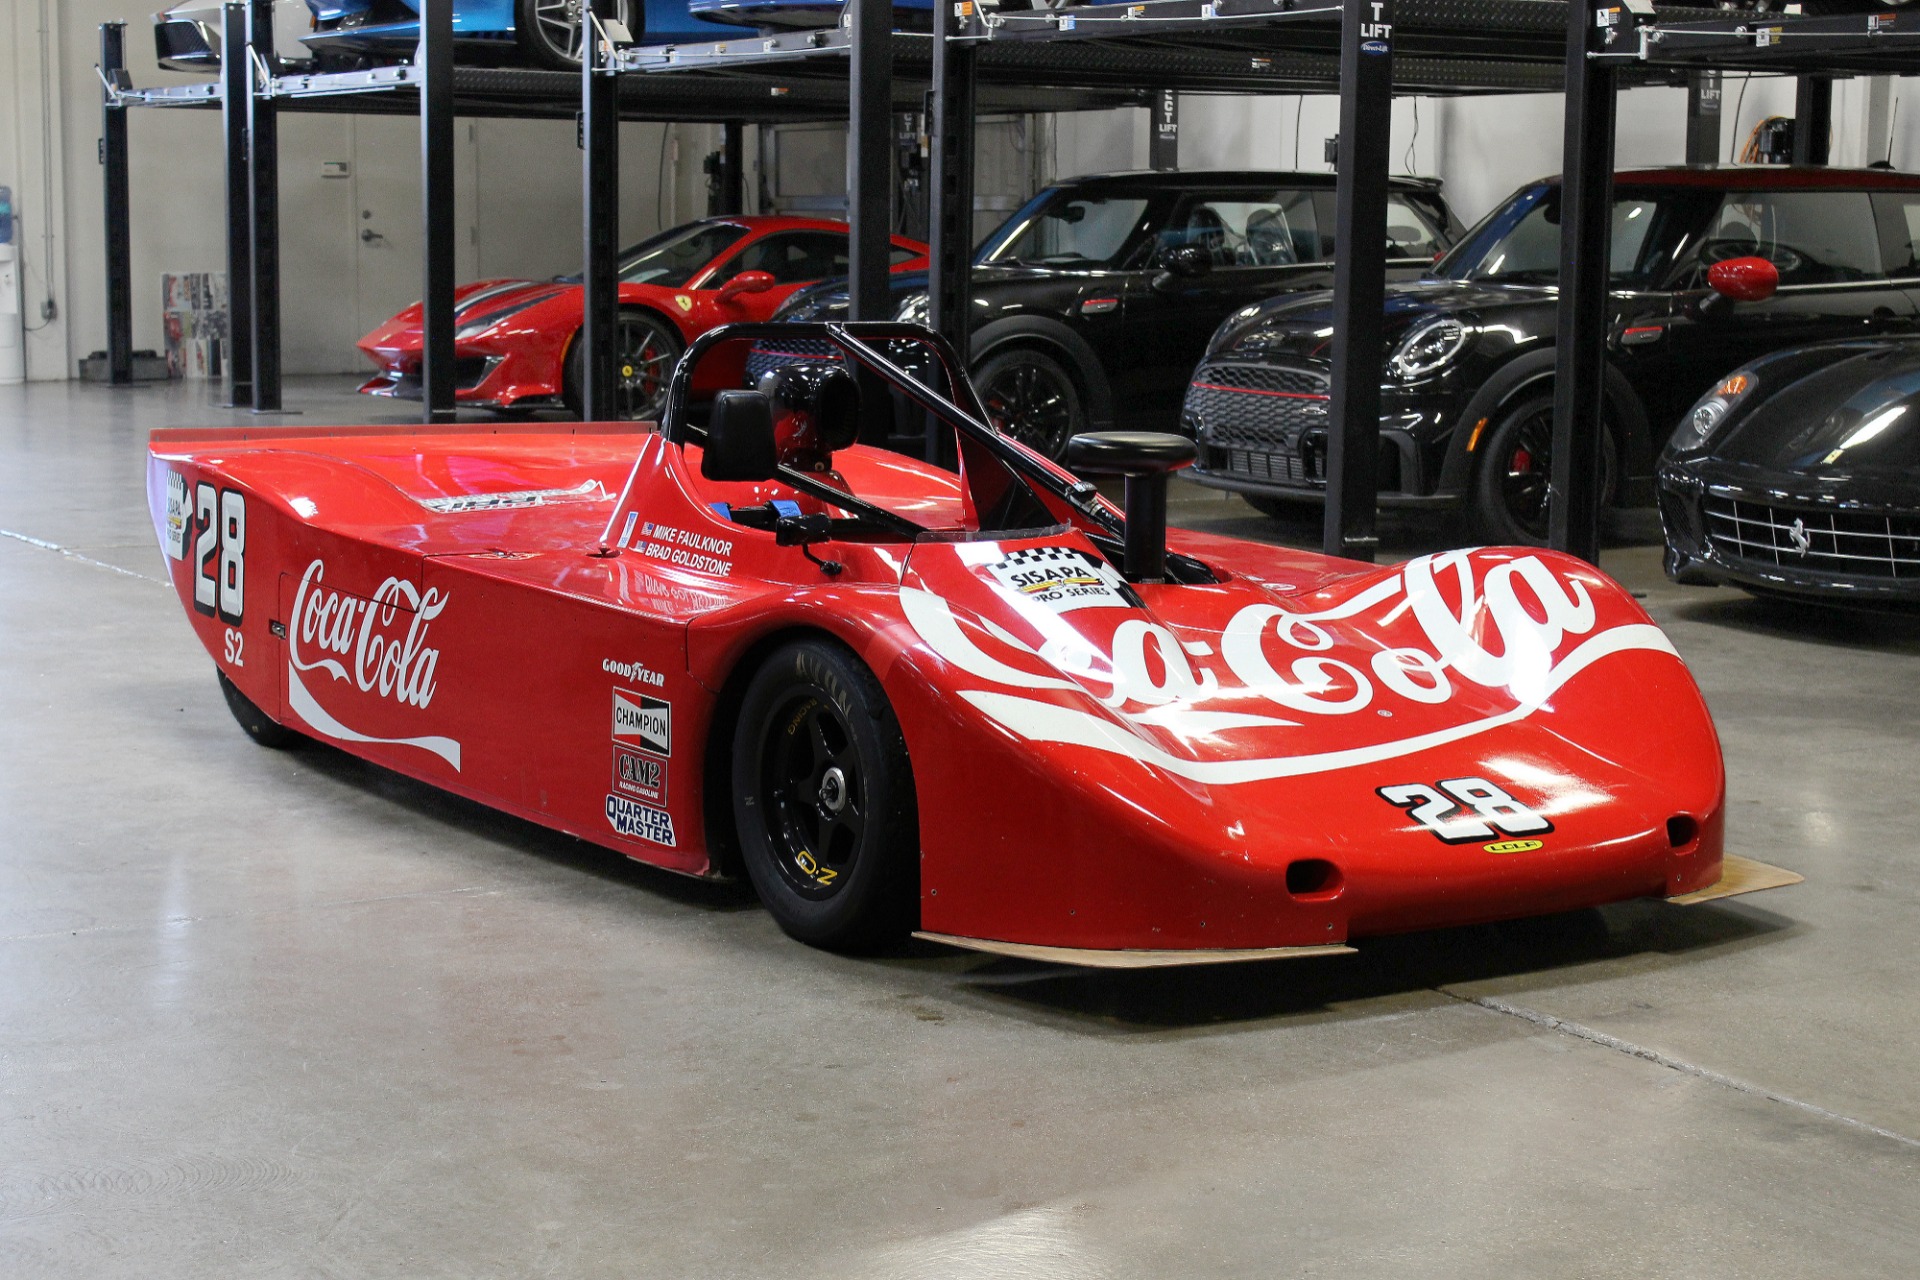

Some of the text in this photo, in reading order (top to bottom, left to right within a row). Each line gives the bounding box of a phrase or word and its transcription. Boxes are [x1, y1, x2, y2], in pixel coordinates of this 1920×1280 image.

[1361, 23, 1392, 38] LIFT
[1700, 89, 1720, 100] LIFT
[1159, 124, 1177, 132] LIFT
[193, 481, 246, 627] 28
[653, 525, 733, 557] MIKE FAULKNOR
[645, 543, 733, 577] BRAD GOLDSTONE
[1010, 566, 1092, 588] SISAPA
[1032, 586, 1111, 603] PRO SERIES
[224, 627, 244, 667] S2
[289, 559, 450, 709] Coca-Cola
[602, 658, 665, 687] GOODYEAR
[616, 706, 666, 736] CHAMPION
[788, 698, 818, 735] RACING
[618, 753, 660, 789] CAM2
[606, 795, 670, 828] QUARTER
[1375, 777, 1555, 845] 28
[616, 813, 673, 845] MASTER
[1490, 841, 1537, 851] LOLA
